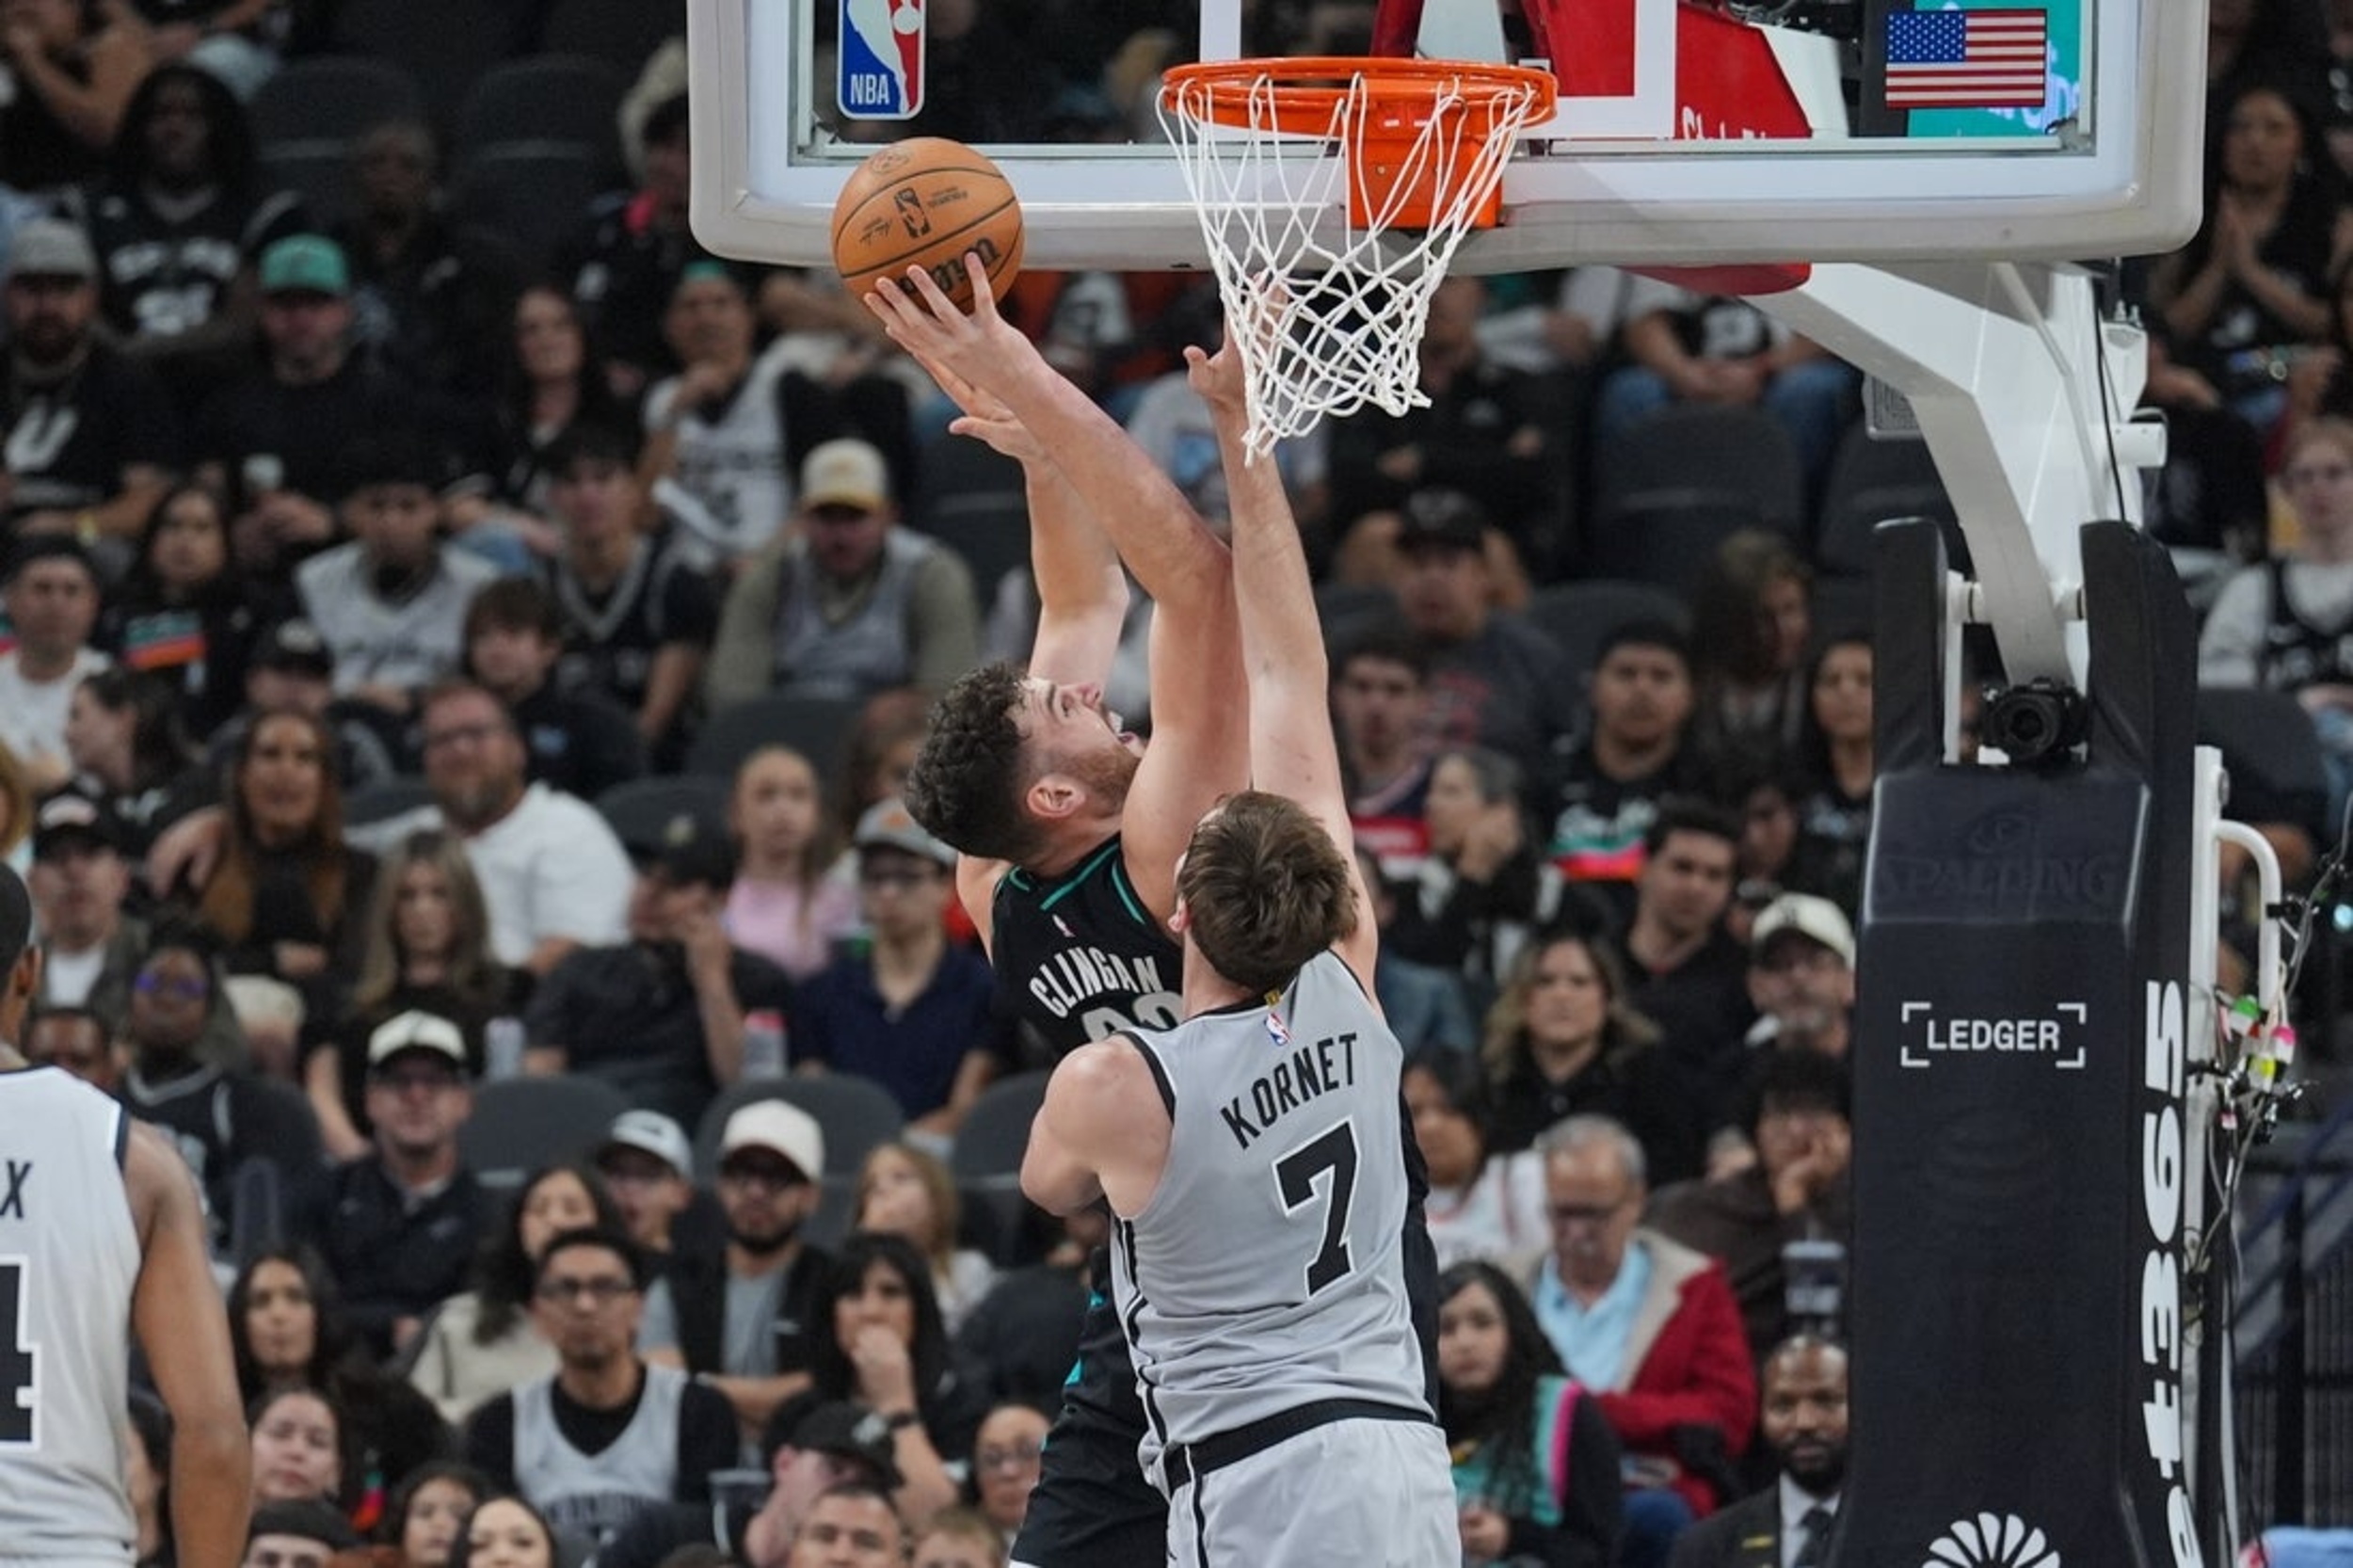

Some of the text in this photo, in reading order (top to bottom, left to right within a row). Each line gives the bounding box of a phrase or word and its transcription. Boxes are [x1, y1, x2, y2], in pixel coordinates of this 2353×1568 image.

[850, 73, 889, 105] NBA
[1029, 947, 1161, 1017] CLINGAN
[1927, 1019, 2060, 1051] LEDGER
[1220, 1032, 1358, 1150] KORNET
[1273, 1116, 1361, 1300] 7
